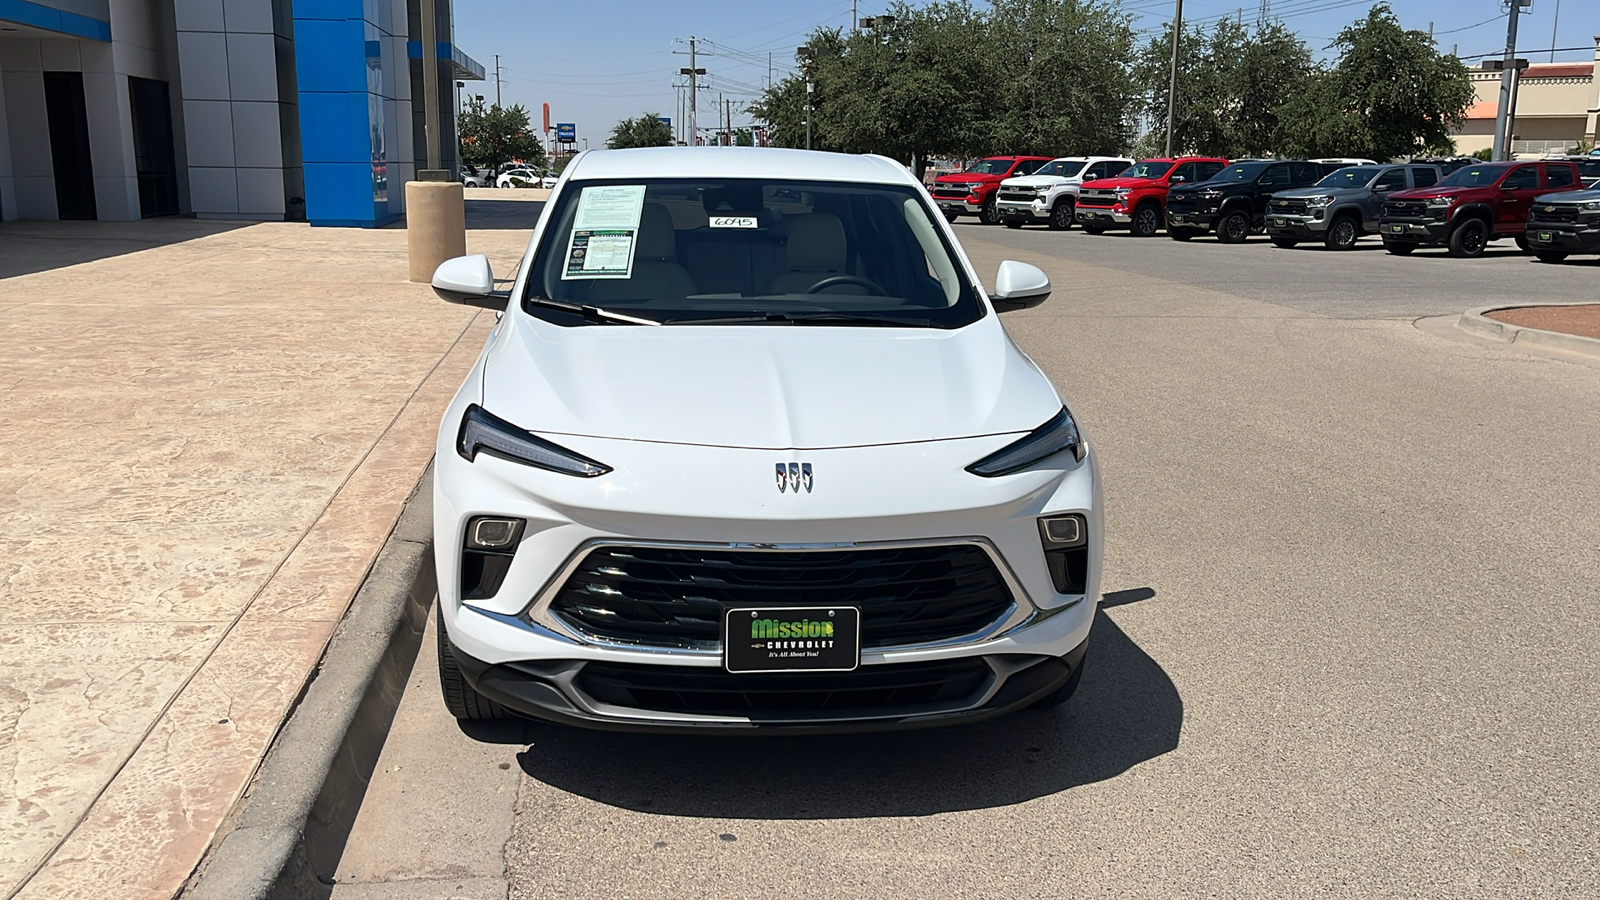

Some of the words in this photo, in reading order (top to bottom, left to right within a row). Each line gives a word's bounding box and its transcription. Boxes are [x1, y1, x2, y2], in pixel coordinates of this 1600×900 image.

[715, 218, 752, 226] 6095
[751, 619, 834, 638] Mission
[767, 640, 834, 649] CHEVROLET
